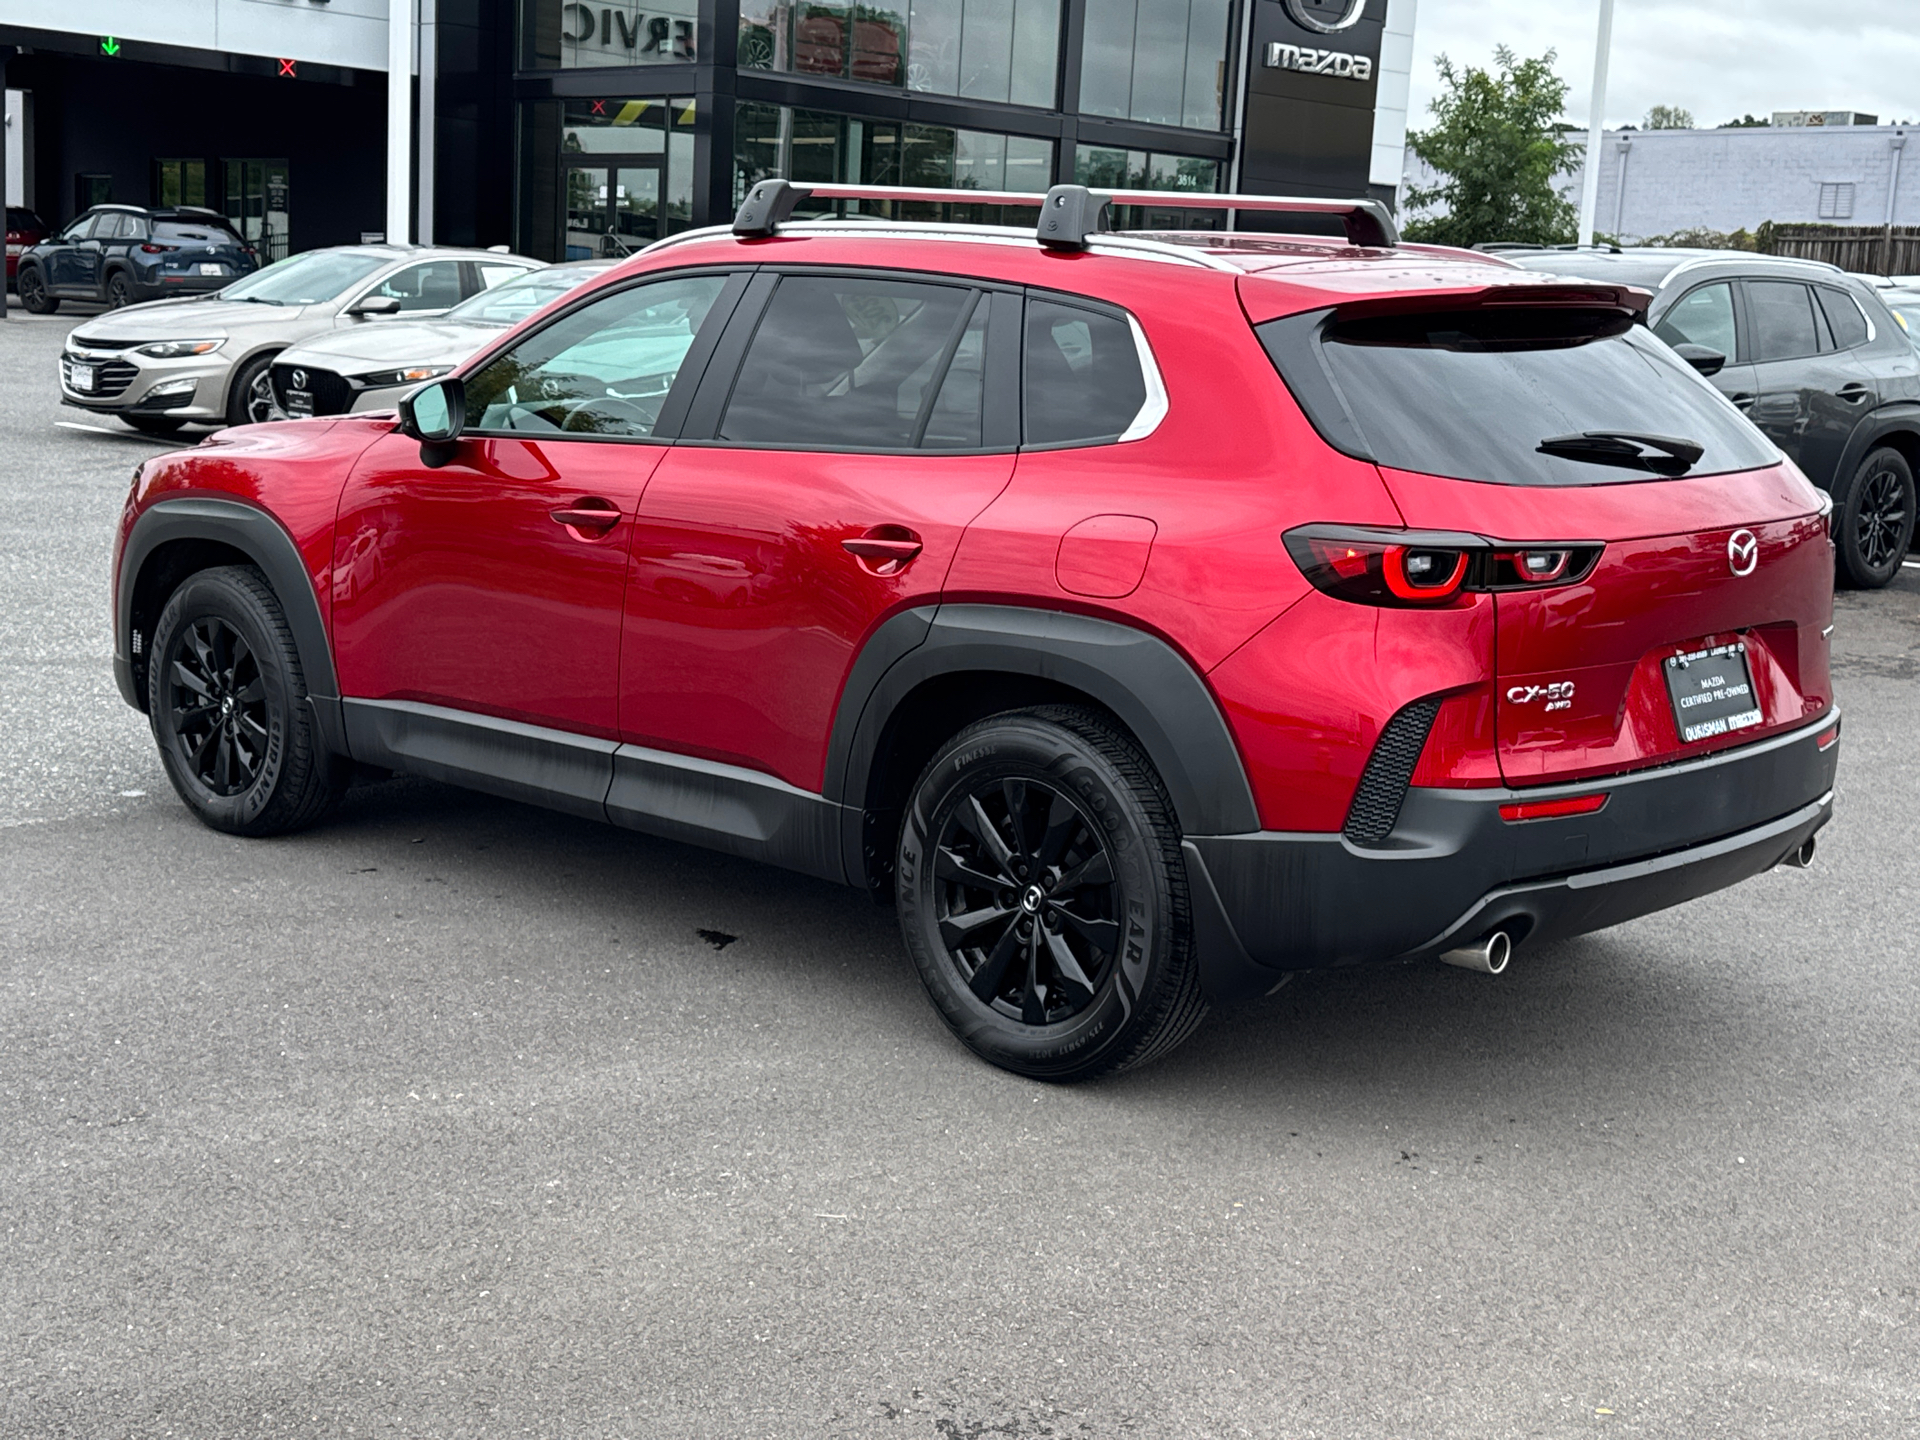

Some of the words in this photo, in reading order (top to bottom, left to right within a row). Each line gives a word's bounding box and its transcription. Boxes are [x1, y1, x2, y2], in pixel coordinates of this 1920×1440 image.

[1507, 681, 1575, 704] CX-50
[1700, 675, 1726, 689] MAZDA
[1544, 700, 1572, 712] AWD
[1680, 692, 1713, 708] CERTIFIED
[1713, 683, 1749, 700] PRE-OWNED
[1685, 719, 1727, 741] OURISMAN
[1077, 775, 1145, 966] GOODYEAR
[901, 845, 961, 1014] ASSURANCE
